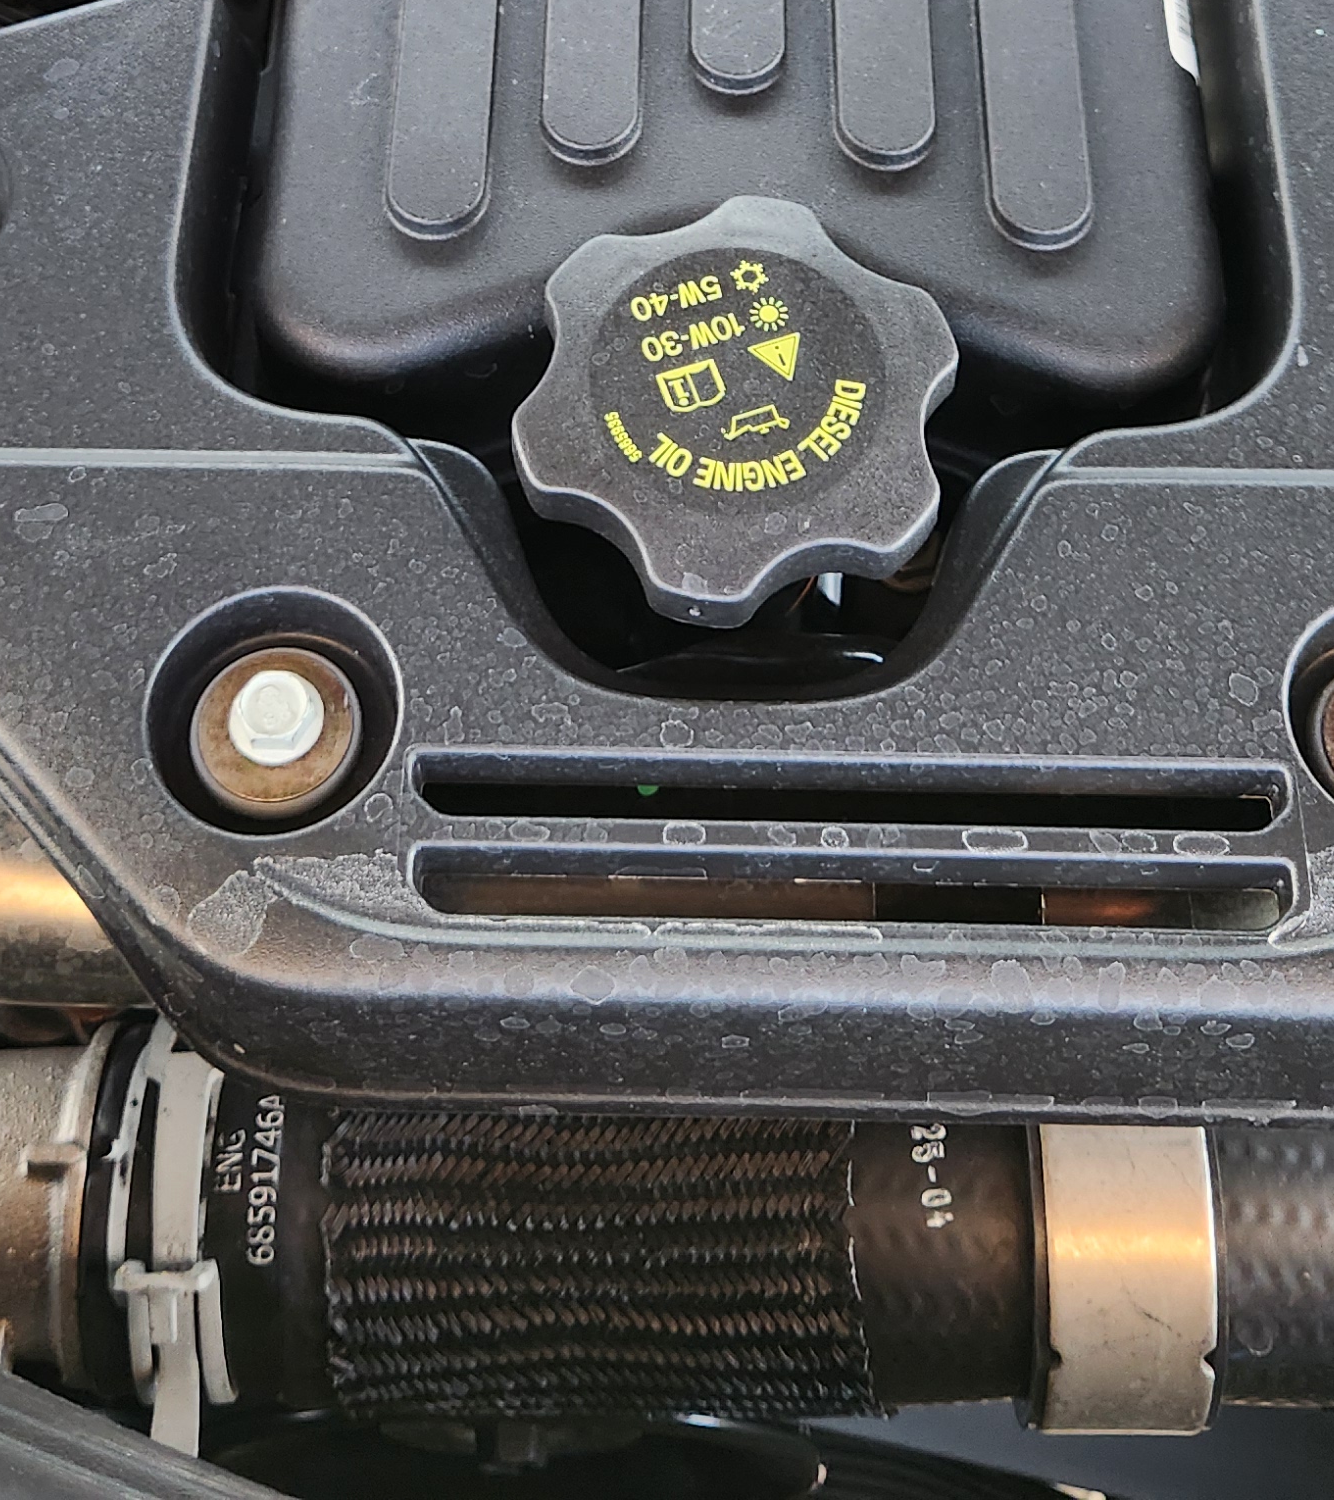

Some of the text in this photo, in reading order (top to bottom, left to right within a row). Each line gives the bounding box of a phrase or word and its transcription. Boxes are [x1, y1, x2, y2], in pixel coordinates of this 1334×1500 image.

[630, 275, 723, 322] 5W-40
[640, 312, 746, 363] 10W-30
[648, 378, 867, 493] DIESEL ENGINE OIL
[212, 1127, 249, 1195] ENG
